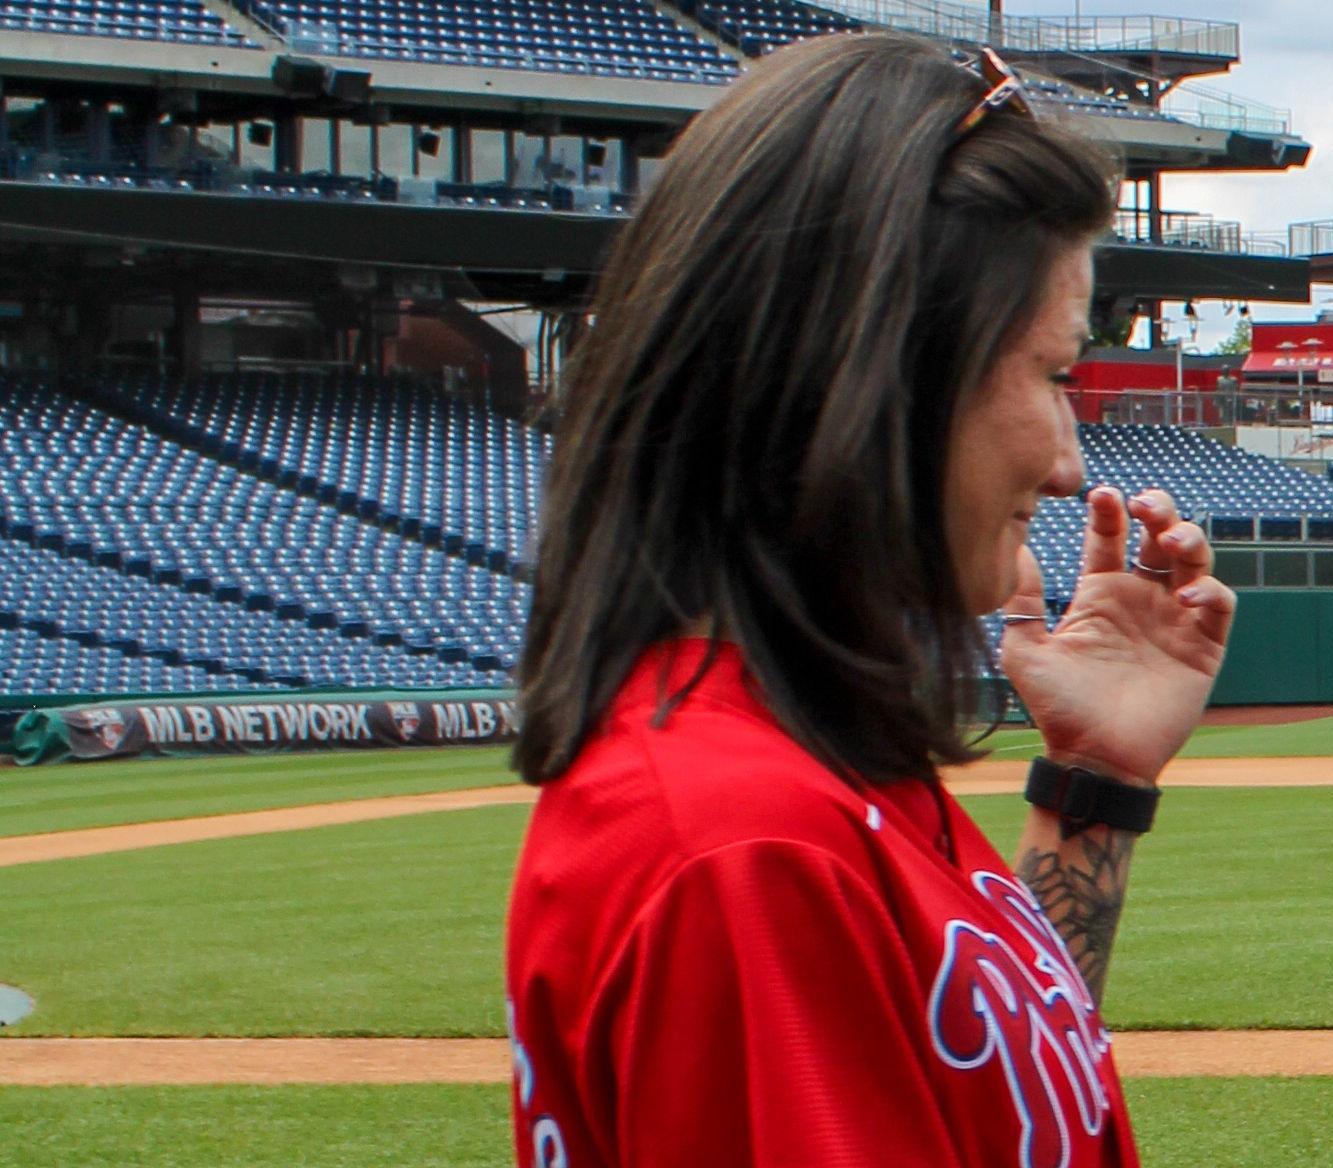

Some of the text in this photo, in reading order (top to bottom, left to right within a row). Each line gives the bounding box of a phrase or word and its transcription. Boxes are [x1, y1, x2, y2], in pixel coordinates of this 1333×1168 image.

[139, 704, 372, 743] MLB NETWORK
[432, 702, 496, 738] MLB
